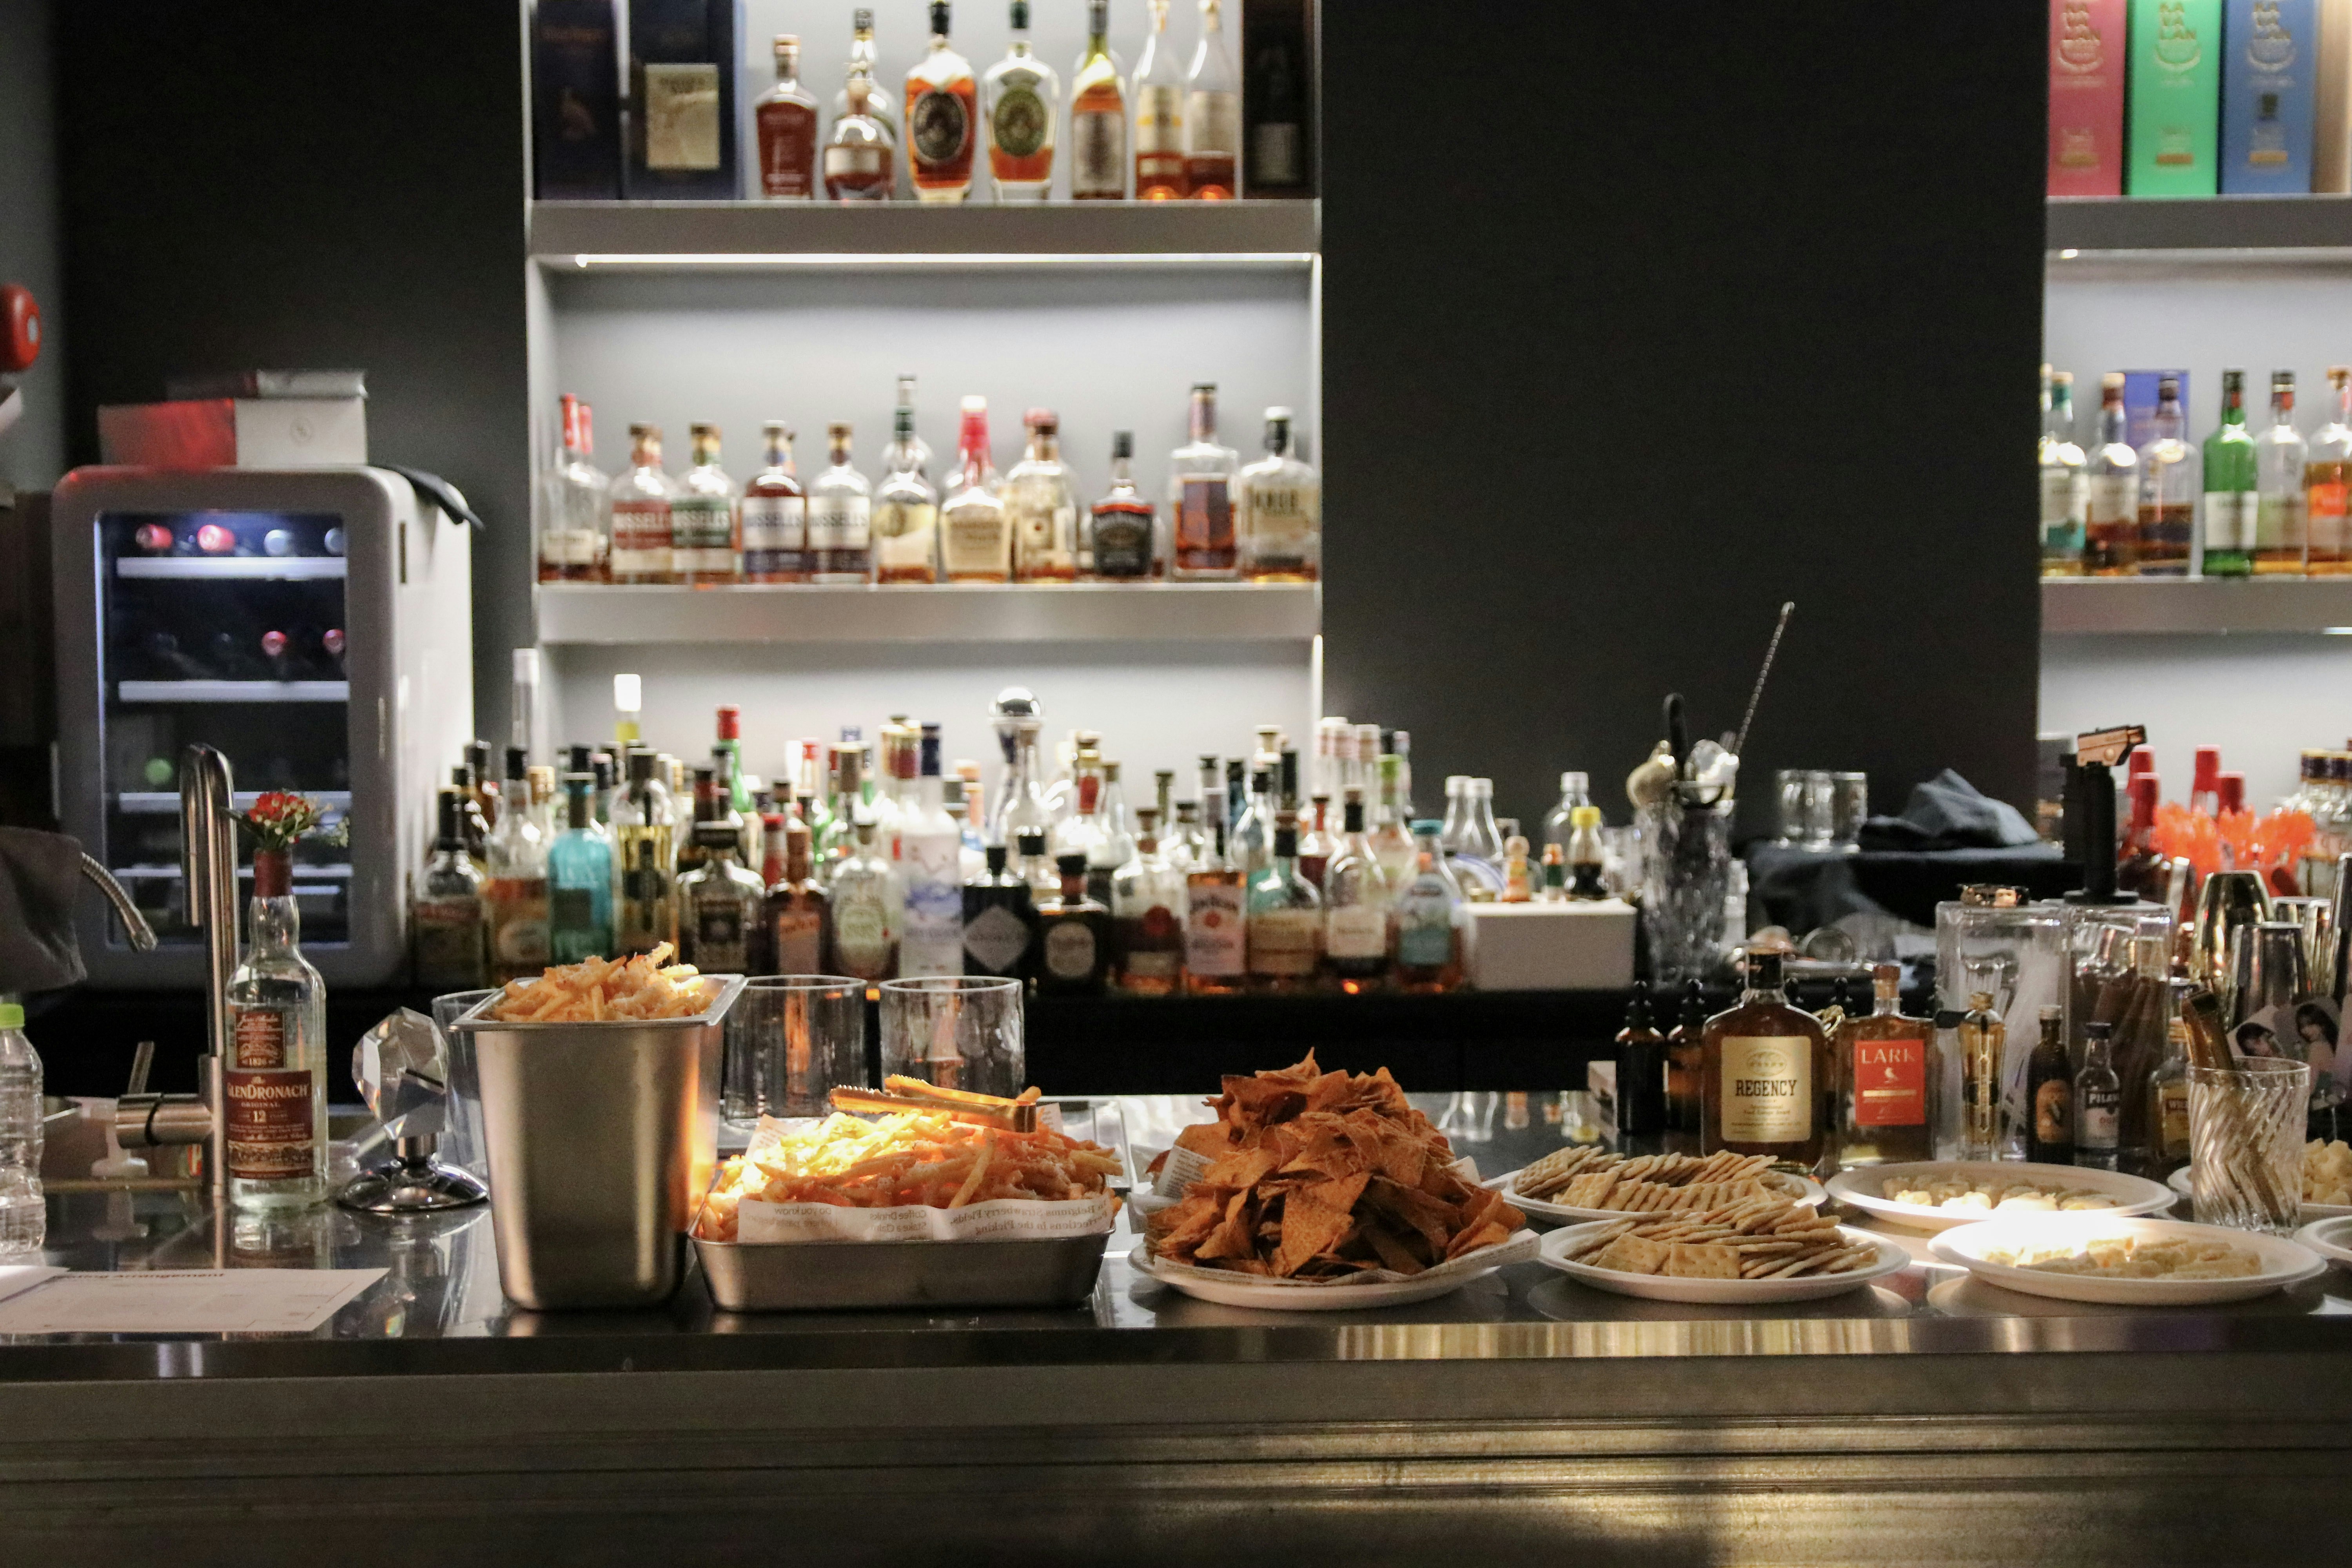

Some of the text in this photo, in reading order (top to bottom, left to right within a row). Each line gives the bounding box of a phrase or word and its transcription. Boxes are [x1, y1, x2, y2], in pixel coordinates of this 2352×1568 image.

[1861, 1048, 1916, 1064] LARK
[1735, 1080, 1797, 1096] REGENCY
[253, 1110, 267, 1123] 12
